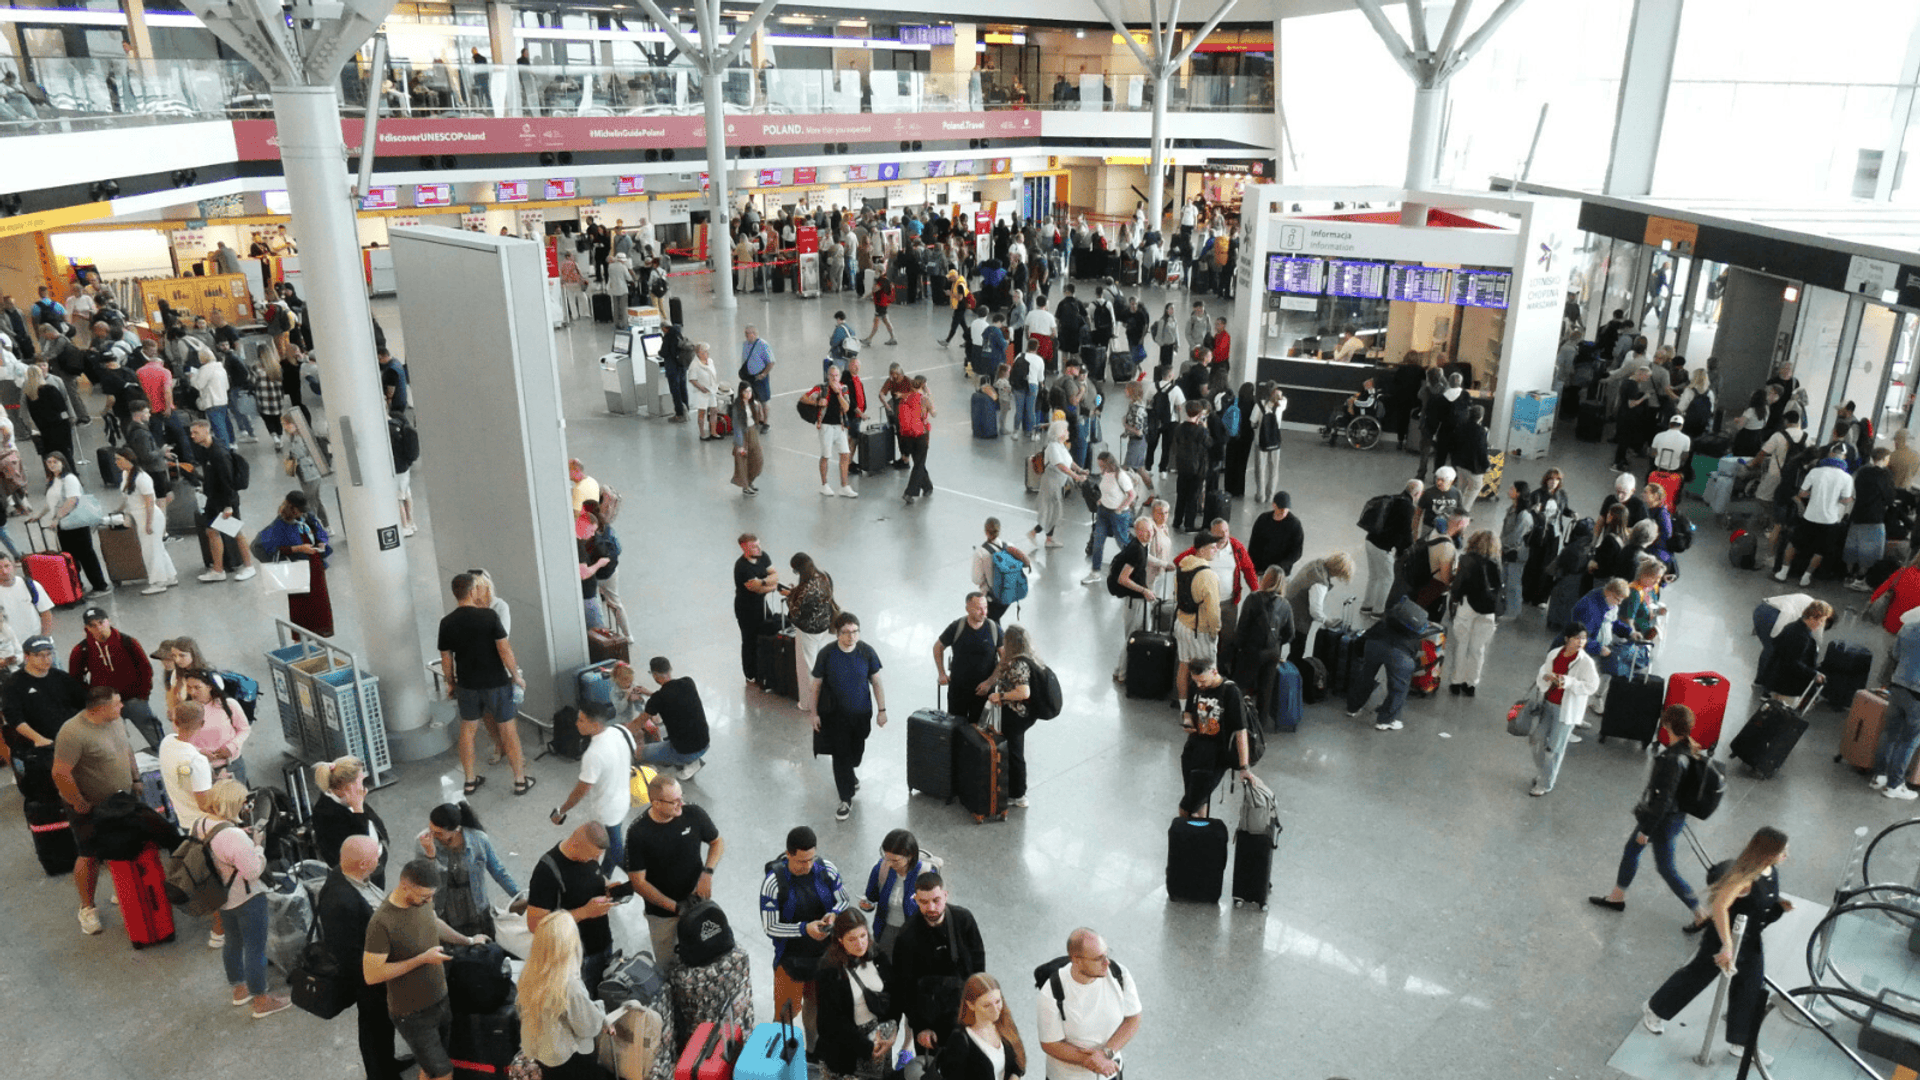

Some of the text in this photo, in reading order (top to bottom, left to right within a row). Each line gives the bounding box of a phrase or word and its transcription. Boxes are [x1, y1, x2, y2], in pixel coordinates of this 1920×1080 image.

[763, 124, 804, 136] POLAND.
[942, 120, 985, 130] Poland.Travel
[379, 131, 486, 142] #discoverUNESCOPoland
[589, 128, 665, 138] #MichelinGuidePoland
[1311, 229, 1352, 240] Informacja
